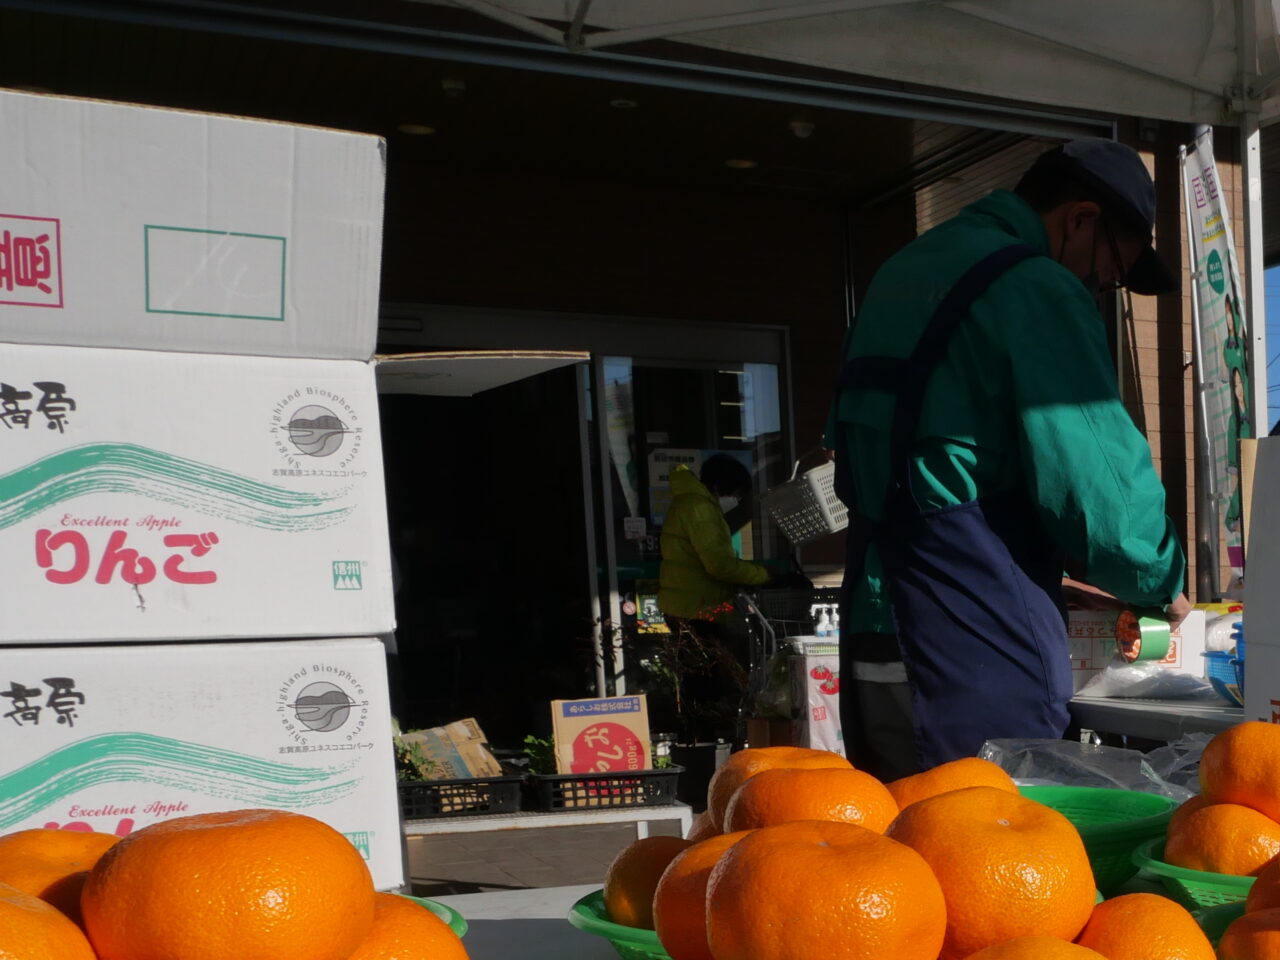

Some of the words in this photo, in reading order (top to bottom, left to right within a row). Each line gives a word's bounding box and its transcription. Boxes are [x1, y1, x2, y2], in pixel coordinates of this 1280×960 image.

[61, 514, 131, 528] Excellent
[136, 514, 182, 530] Apple
[35, 528, 219, 584] りんご
[333, 561, 360, 575] 信州
[0, 677, 85, 727] 高原
[69, 804, 136, 819] Excellent
[143, 800, 190, 816] Apple
